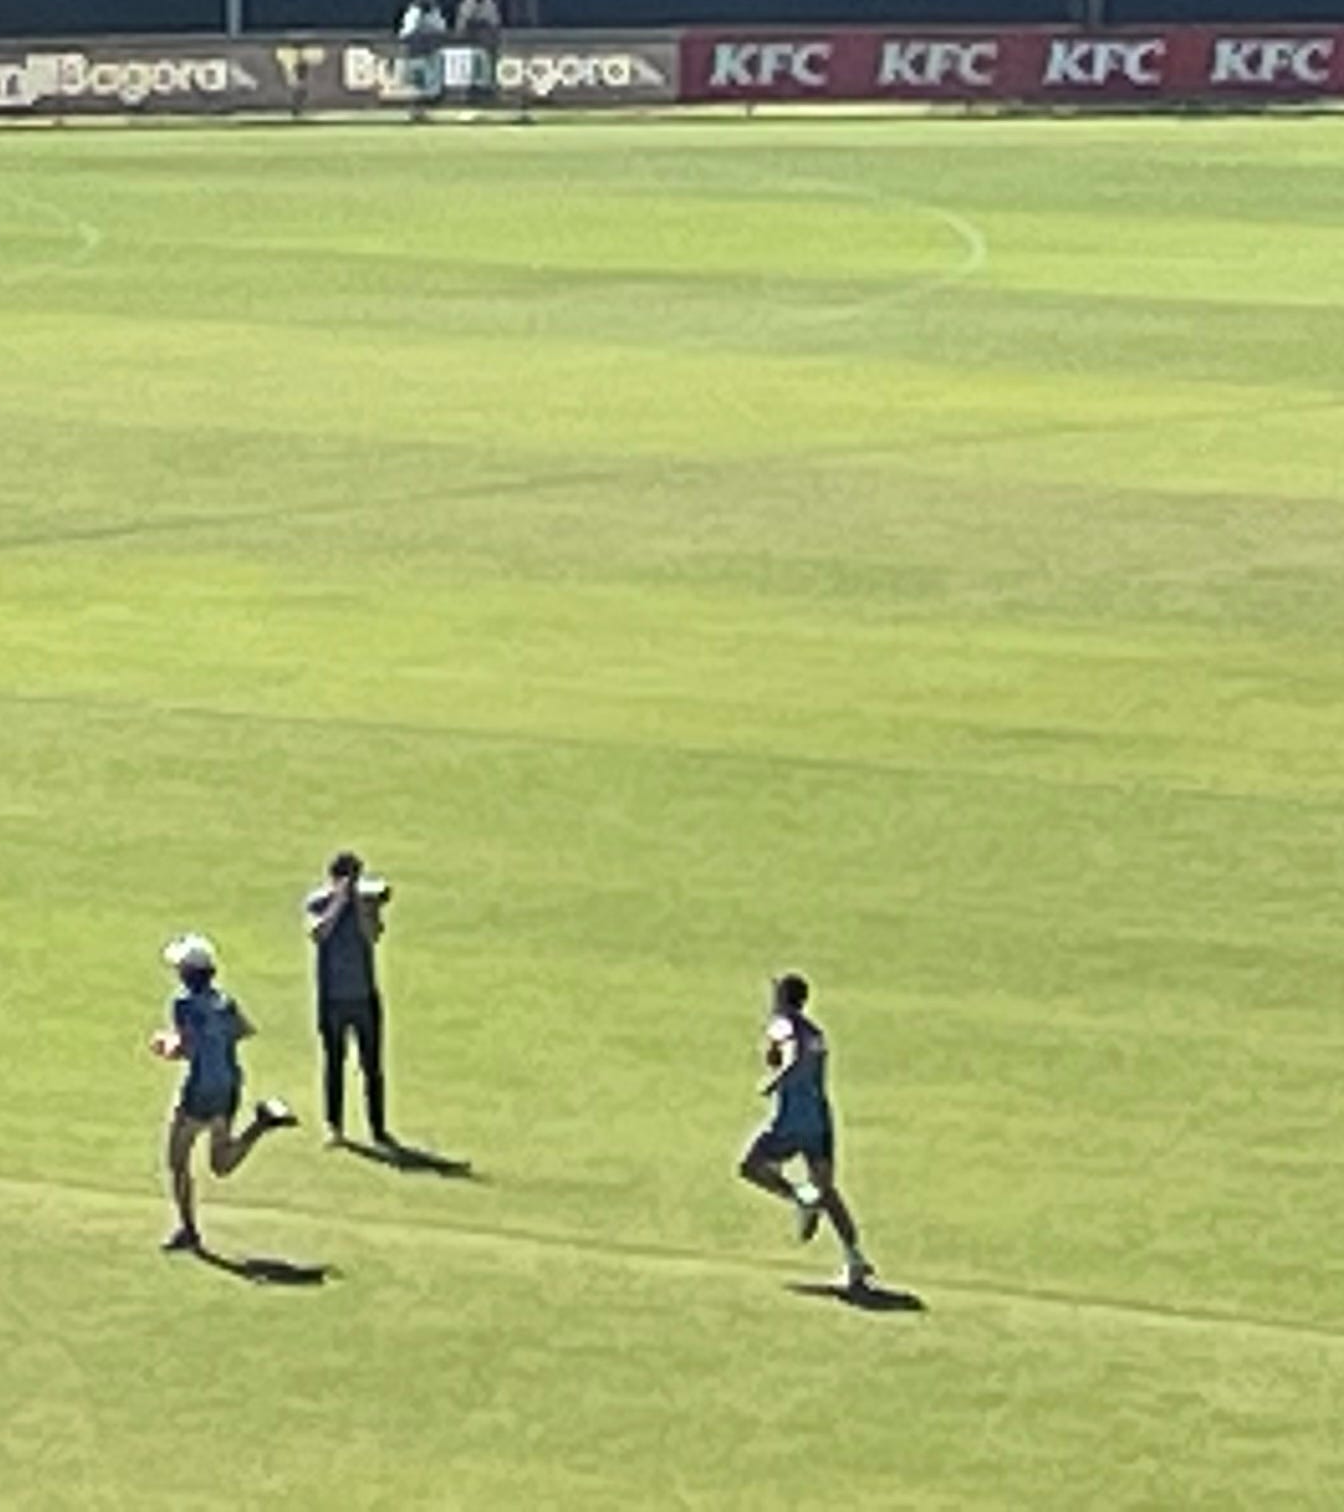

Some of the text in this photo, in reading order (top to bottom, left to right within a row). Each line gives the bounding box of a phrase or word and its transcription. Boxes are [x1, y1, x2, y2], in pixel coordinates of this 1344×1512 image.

[710, 43, 830, 85] KFC
[878, 43, 997, 84] KFC
[1044, 40, 1165, 83] KFC
[1211, 40, 1333, 82] KFC
